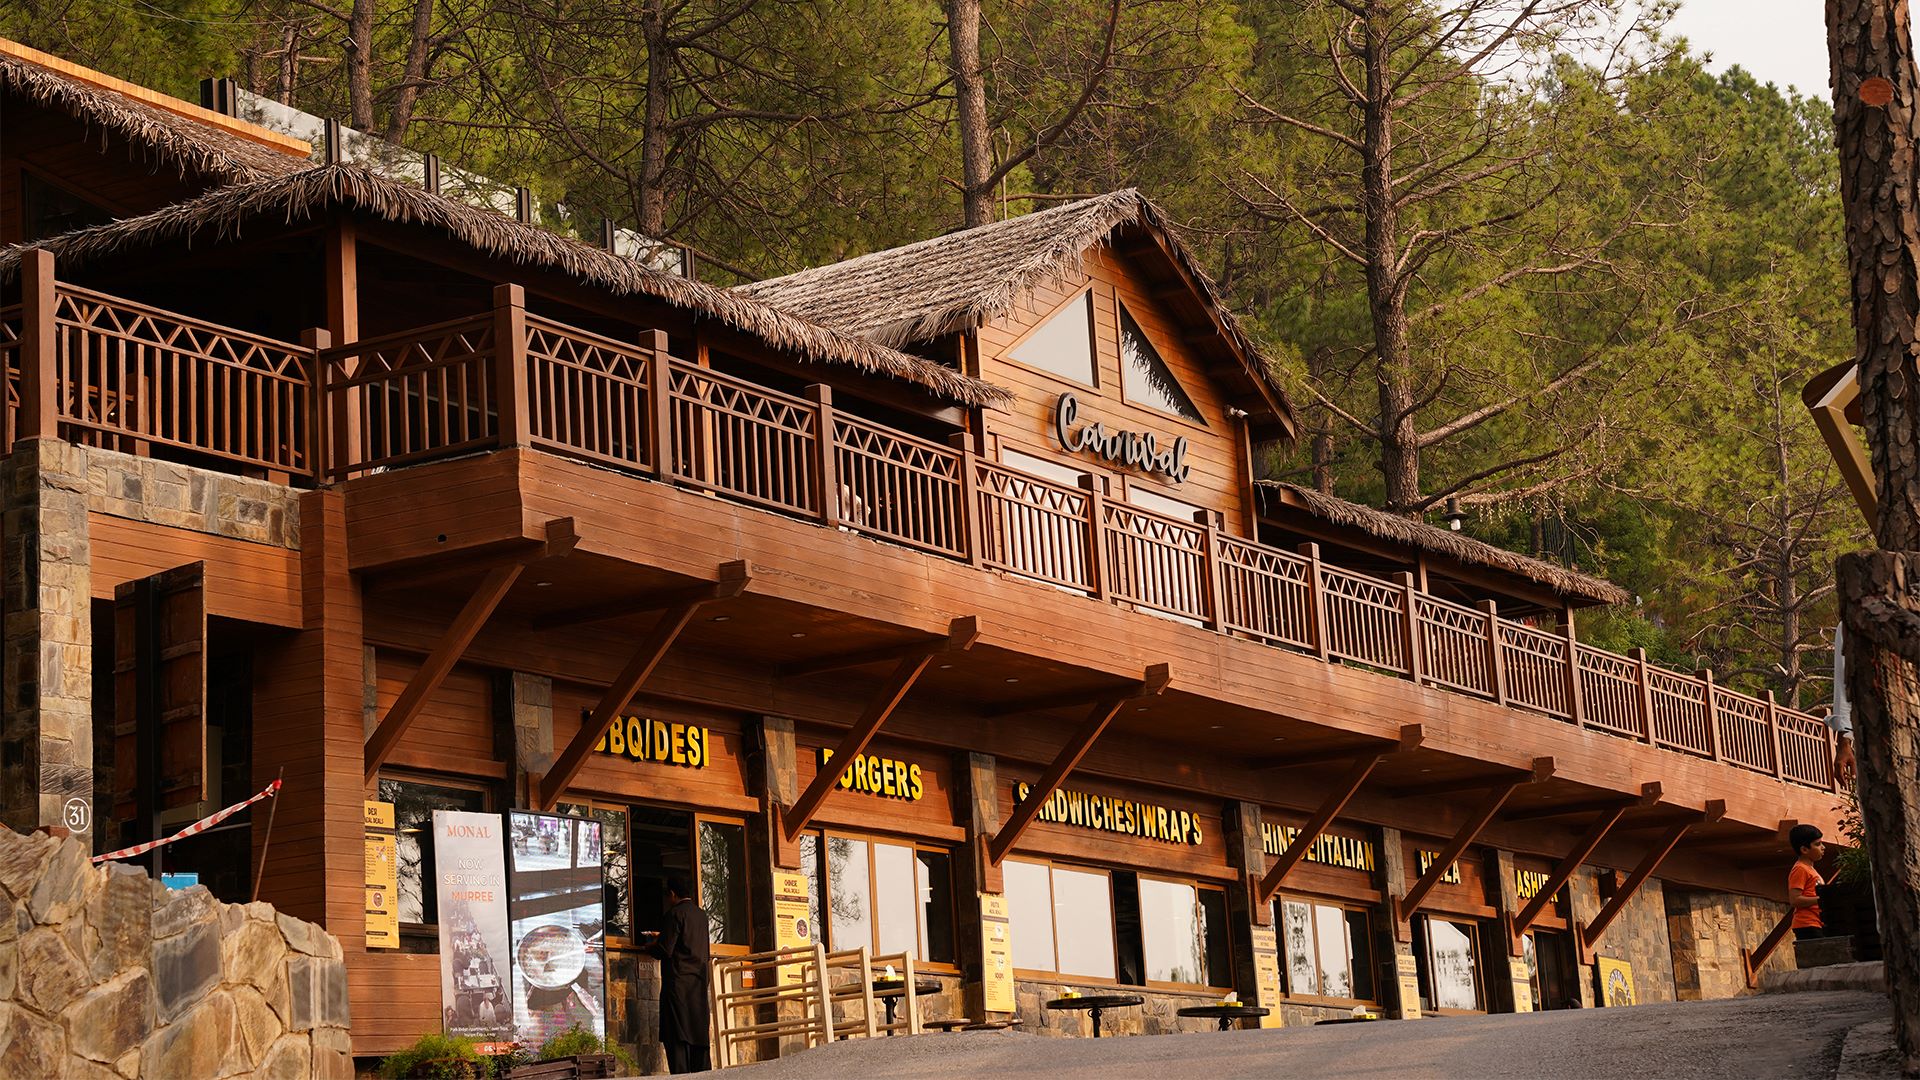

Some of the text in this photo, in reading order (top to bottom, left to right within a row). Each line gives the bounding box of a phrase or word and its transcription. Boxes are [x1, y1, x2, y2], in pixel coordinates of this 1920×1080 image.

[1056, 392, 1190, 483] Carnival
[69, 805, 85, 826] 31
[447, 825, 491, 838] MONAL
[458, 857, 482, 870] NOW
[443, 874, 500, 890] SERVING IN
[452, 890, 493, 902] MURREE
